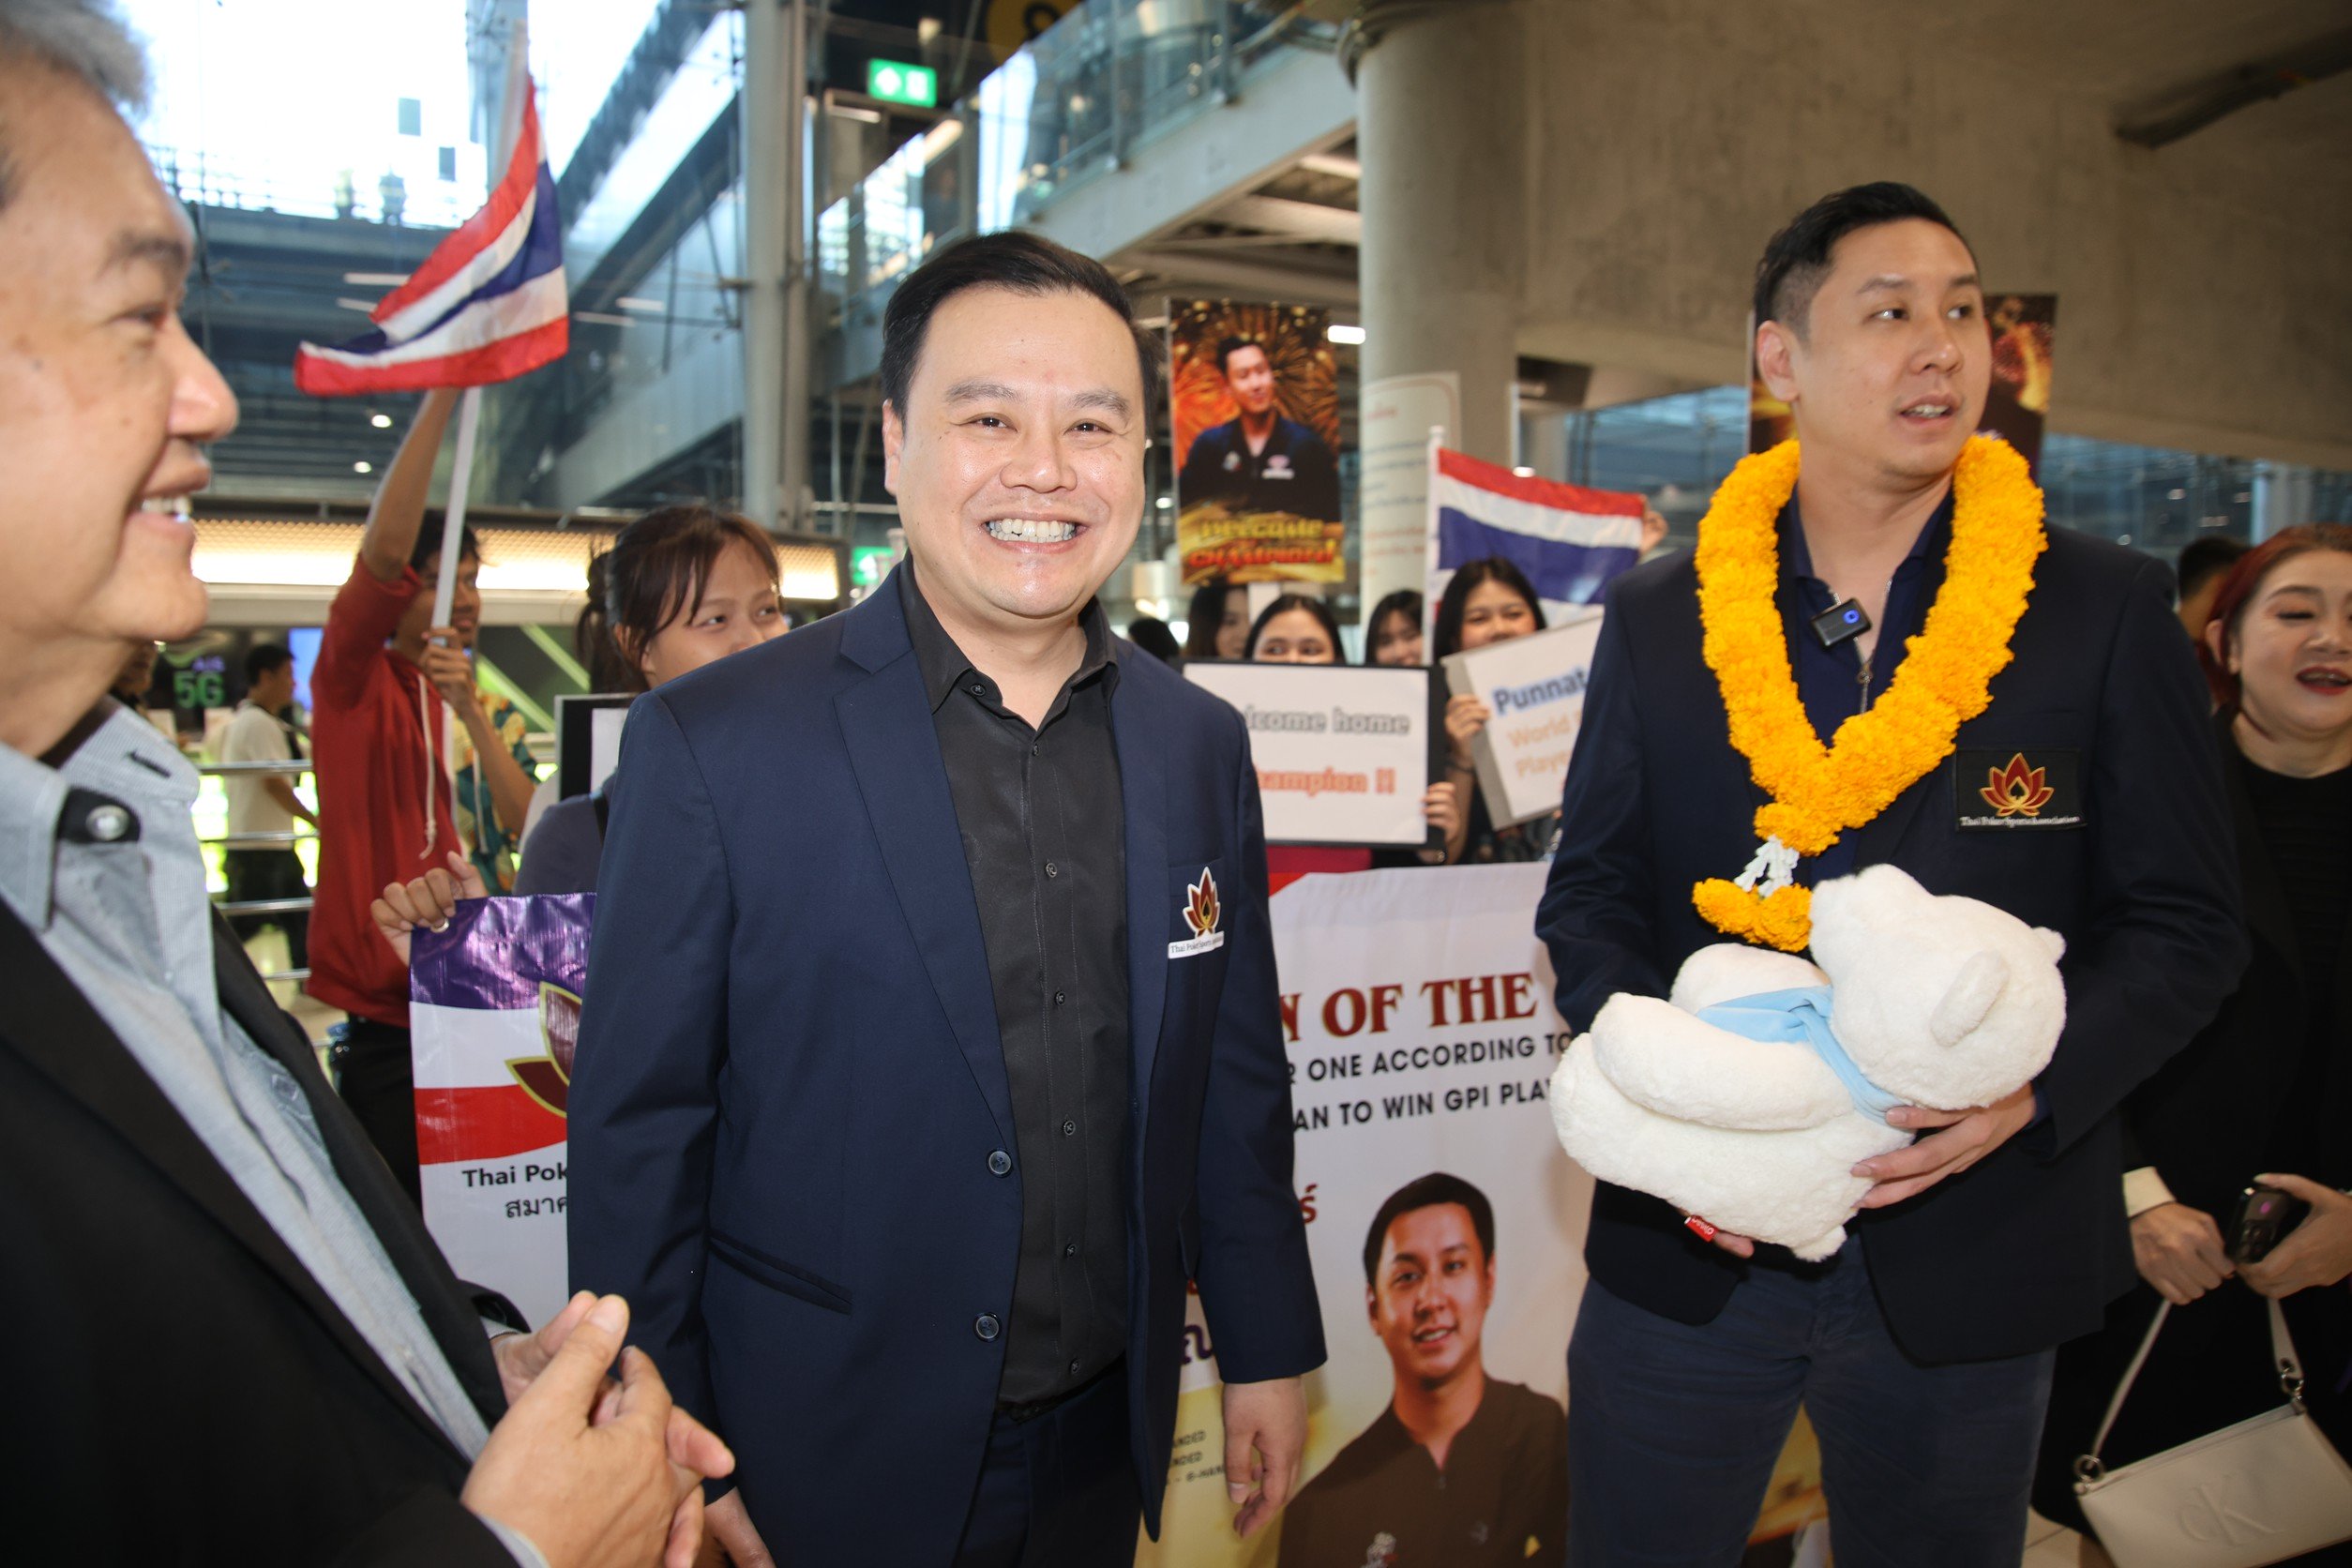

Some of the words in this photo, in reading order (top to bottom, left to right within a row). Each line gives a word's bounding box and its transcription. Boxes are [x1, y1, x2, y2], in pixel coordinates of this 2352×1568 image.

[173, 671, 225, 709] 5G
[1244, 703, 1328, 734] lcome
[1332, 705, 1411, 737] home
[1256, 764, 1368, 798] hampion
[1321, 983, 1404, 1038] OF
[1418, 972, 1538, 1029] THE
[1307, 1054, 1363, 1082] ONE
[1372, 1035, 1535, 1075] ACCORDING
[1545, 1033, 1572, 1056] TO
[1294, 1105, 1330, 1131] AN
[1338, 1099, 1373, 1124] TO
[1383, 1092, 1434, 1120] WIN
[1443, 1084, 1489, 1112] GPI
[461, 1166, 516, 1188] Thai
